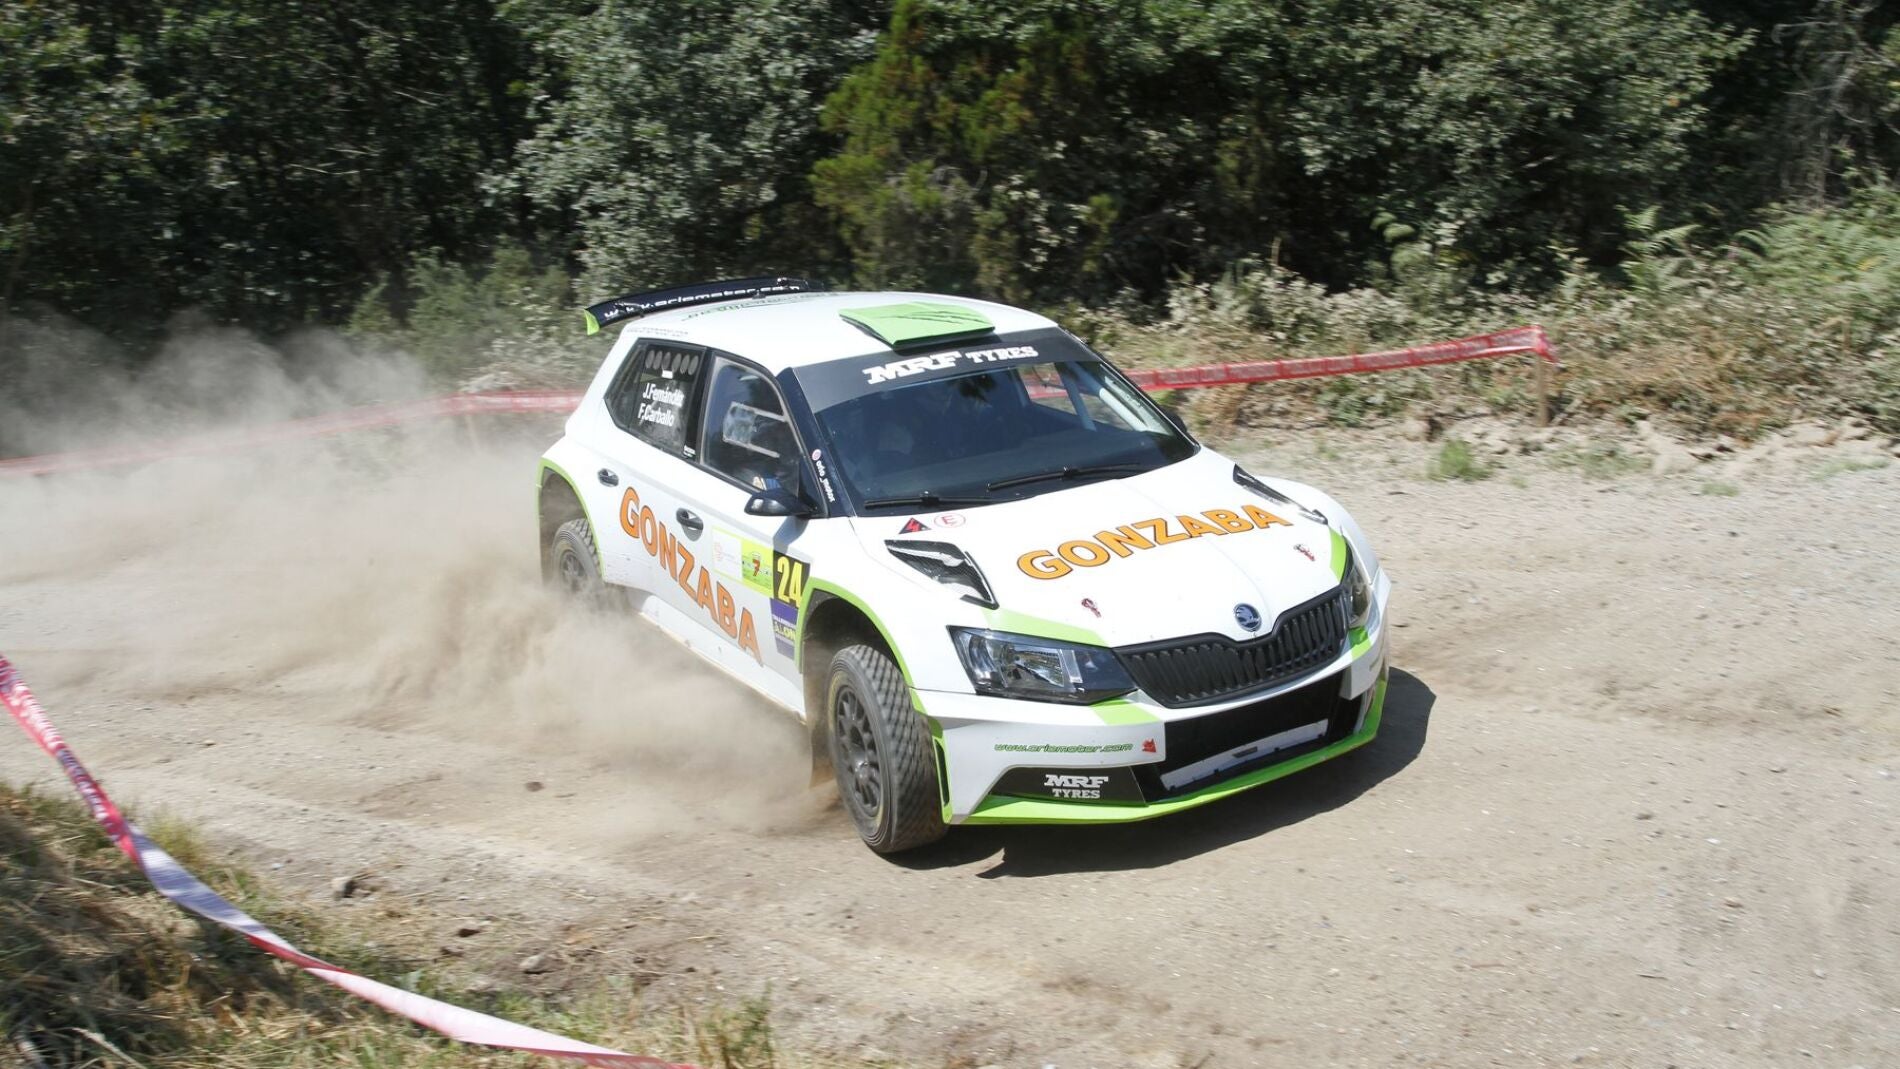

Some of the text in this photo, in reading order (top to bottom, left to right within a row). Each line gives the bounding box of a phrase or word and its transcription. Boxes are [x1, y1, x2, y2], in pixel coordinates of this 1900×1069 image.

[862, 346, 1039, 384] MRF TYRES
[941, 514, 958, 525] E
[1017, 504, 1294, 580] GONZABA
[619, 486, 764, 668] GONZABA
[777, 556, 803, 608] 24
[1043, 773, 1109, 789] MRF
[1052, 788, 1101, 799] TYRES
